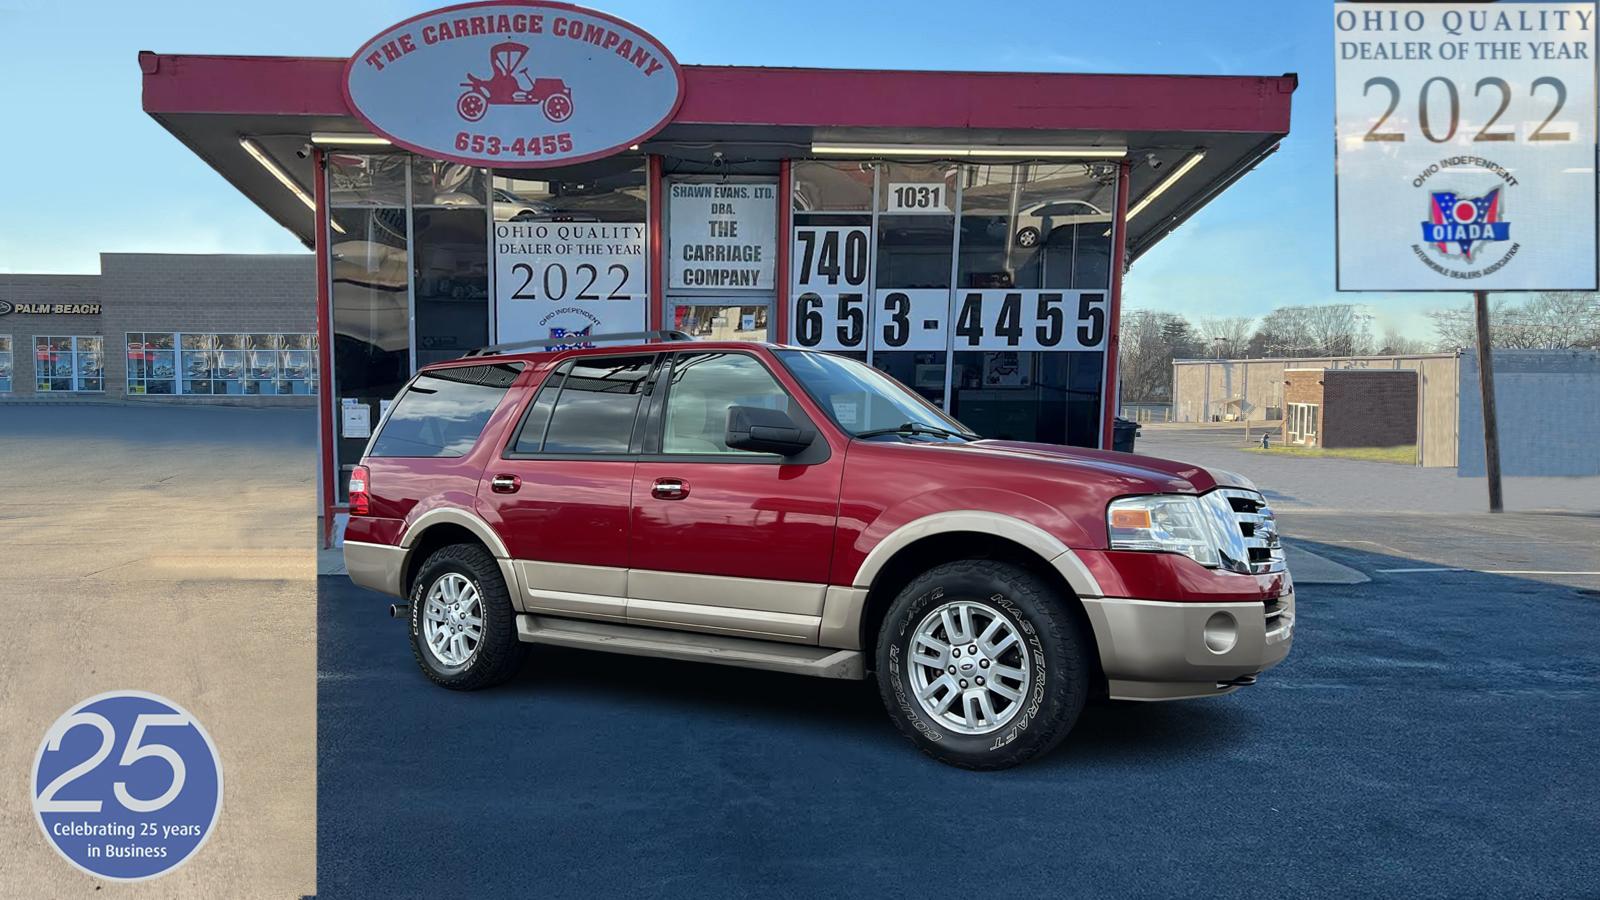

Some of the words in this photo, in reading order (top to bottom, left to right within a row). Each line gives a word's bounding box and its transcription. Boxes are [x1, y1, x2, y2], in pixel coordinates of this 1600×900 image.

[1336, 10, 1425, 31] OHIO
[1441, 10, 1593, 35] QUALITY
[365, 33, 420, 72] THE
[422, 14, 544, 46] CARRIAGE
[552, 16, 664, 77] COMPANY
[1340, 42, 1433, 60] DEALER
[1439, 42, 1469, 60] OF
[1474, 42, 1521, 60] THE
[1527, 42, 1589, 60] YEAR
[1362, 76, 1571, 143] 2022
[454, 132, 574, 156] 653-4455
[1412, 164, 1439, 188] OHIO
[1440, 156, 1519, 187] INDEPENDENT
[672, 185, 712, 199] SHAWN
[754, 186, 775, 200] LTD.
[894, 187, 940, 208] 1031
[711, 203, 736, 215] DBA.
[497, 226, 548, 239] OHIO
[558, 226, 644, 242] QUALITY
[708, 220, 738, 238] THE
[1433, 224, 1495, 240] OIADA
[499, 244, 552, 255] DEALER
[555, 244, 573, 255] OF
[576, 244, 602, 255] THE
[606, 244, 642, 256] YEAR
[683, 244, 762, 262] CARRIAGE
[797, 230, 868, 286] 740
[511, 263, 631, 300] 2022
[683, 269, 760, 286] COMPANY
[1450, 268, 1482, 279] DEALERS
[14, 303, 51, 314] PALM
[54, 303, 101, 314] BEACH
[539, 312, 556, 327] OHIO
[555, 307, 602, 326] INDEPENDENT
[411, 583, 424, 636] COOPER
[990, 593, 1046, 751] MASTERCRAFT
[889, 644, 943, 742] COURSER
